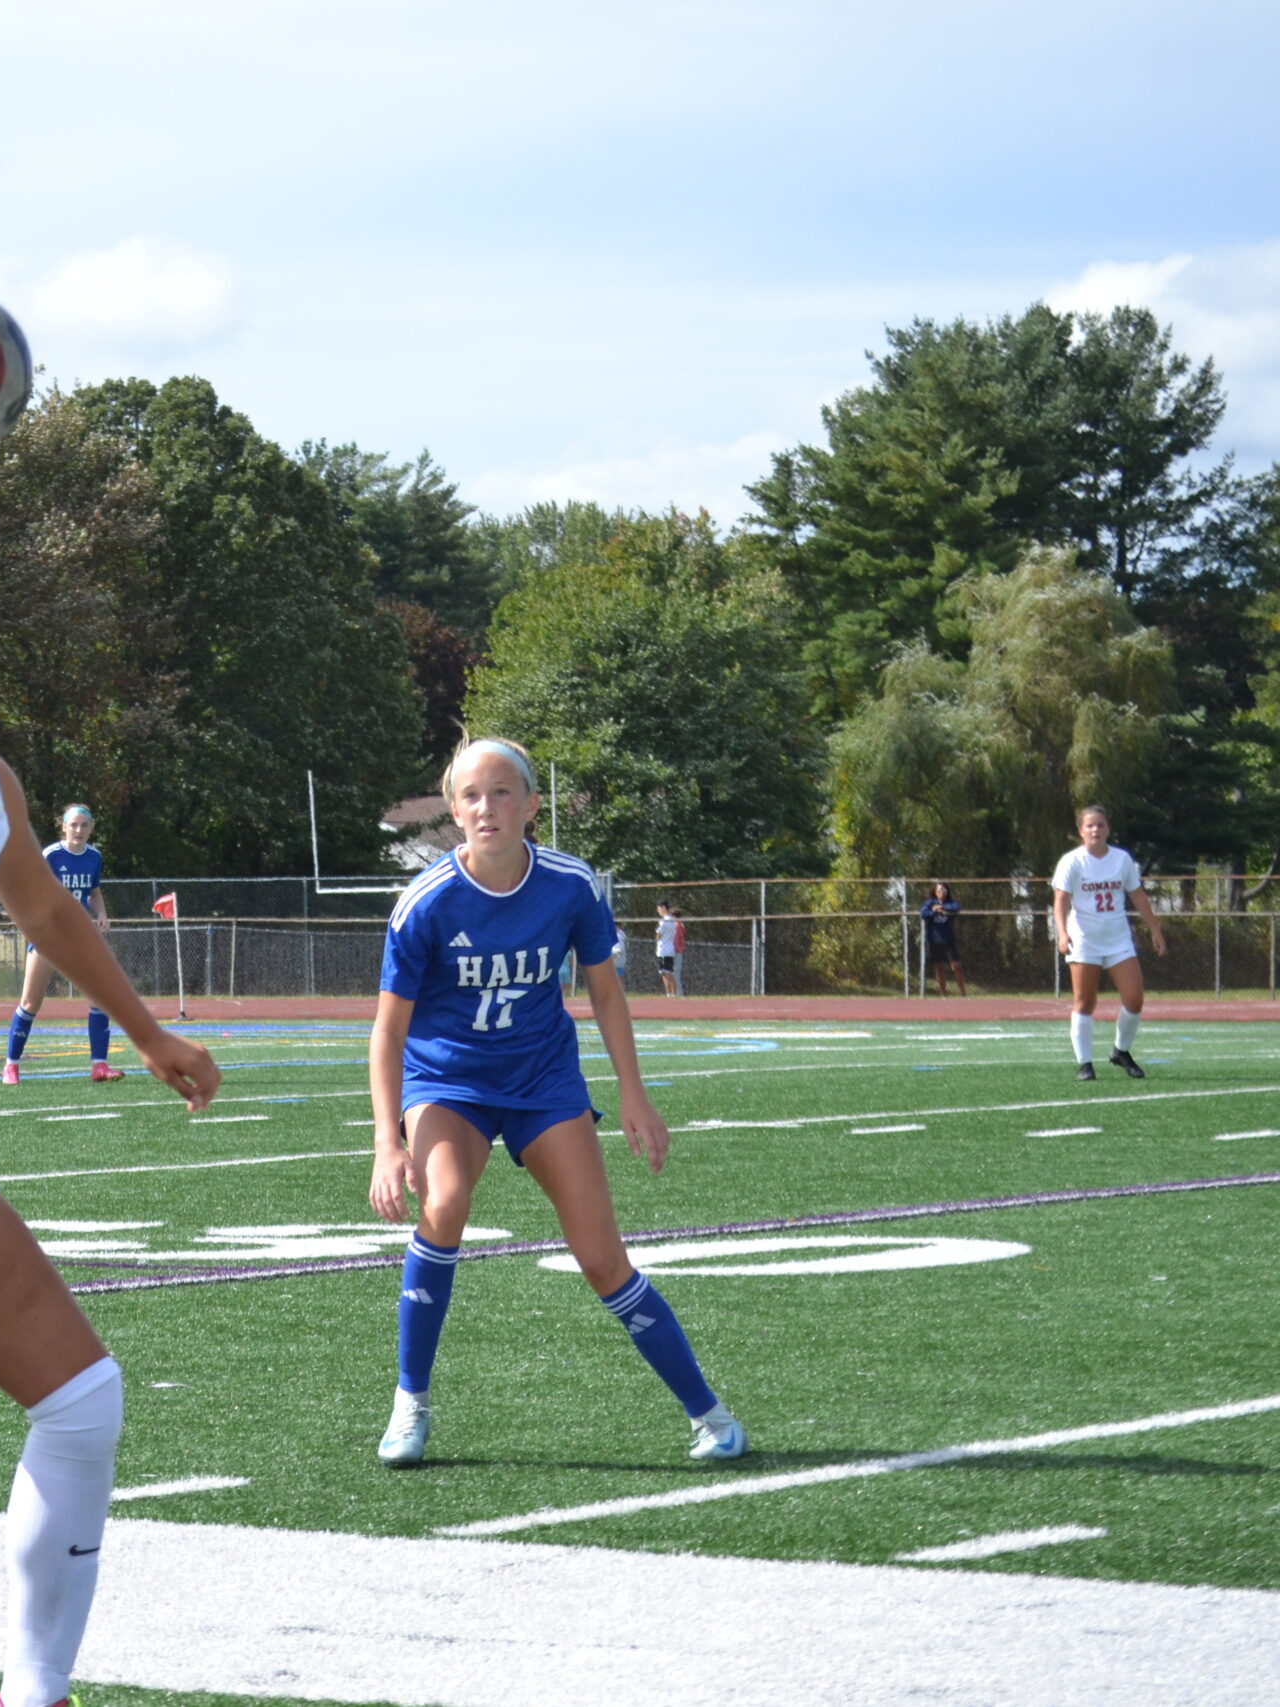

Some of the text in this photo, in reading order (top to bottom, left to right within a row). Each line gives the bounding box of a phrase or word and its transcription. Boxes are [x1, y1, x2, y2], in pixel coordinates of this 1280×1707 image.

[62, 873, 92, 888] HALL
[1095, 892, 1115, 912] 22
[457, 946, 553, 988] HALL
